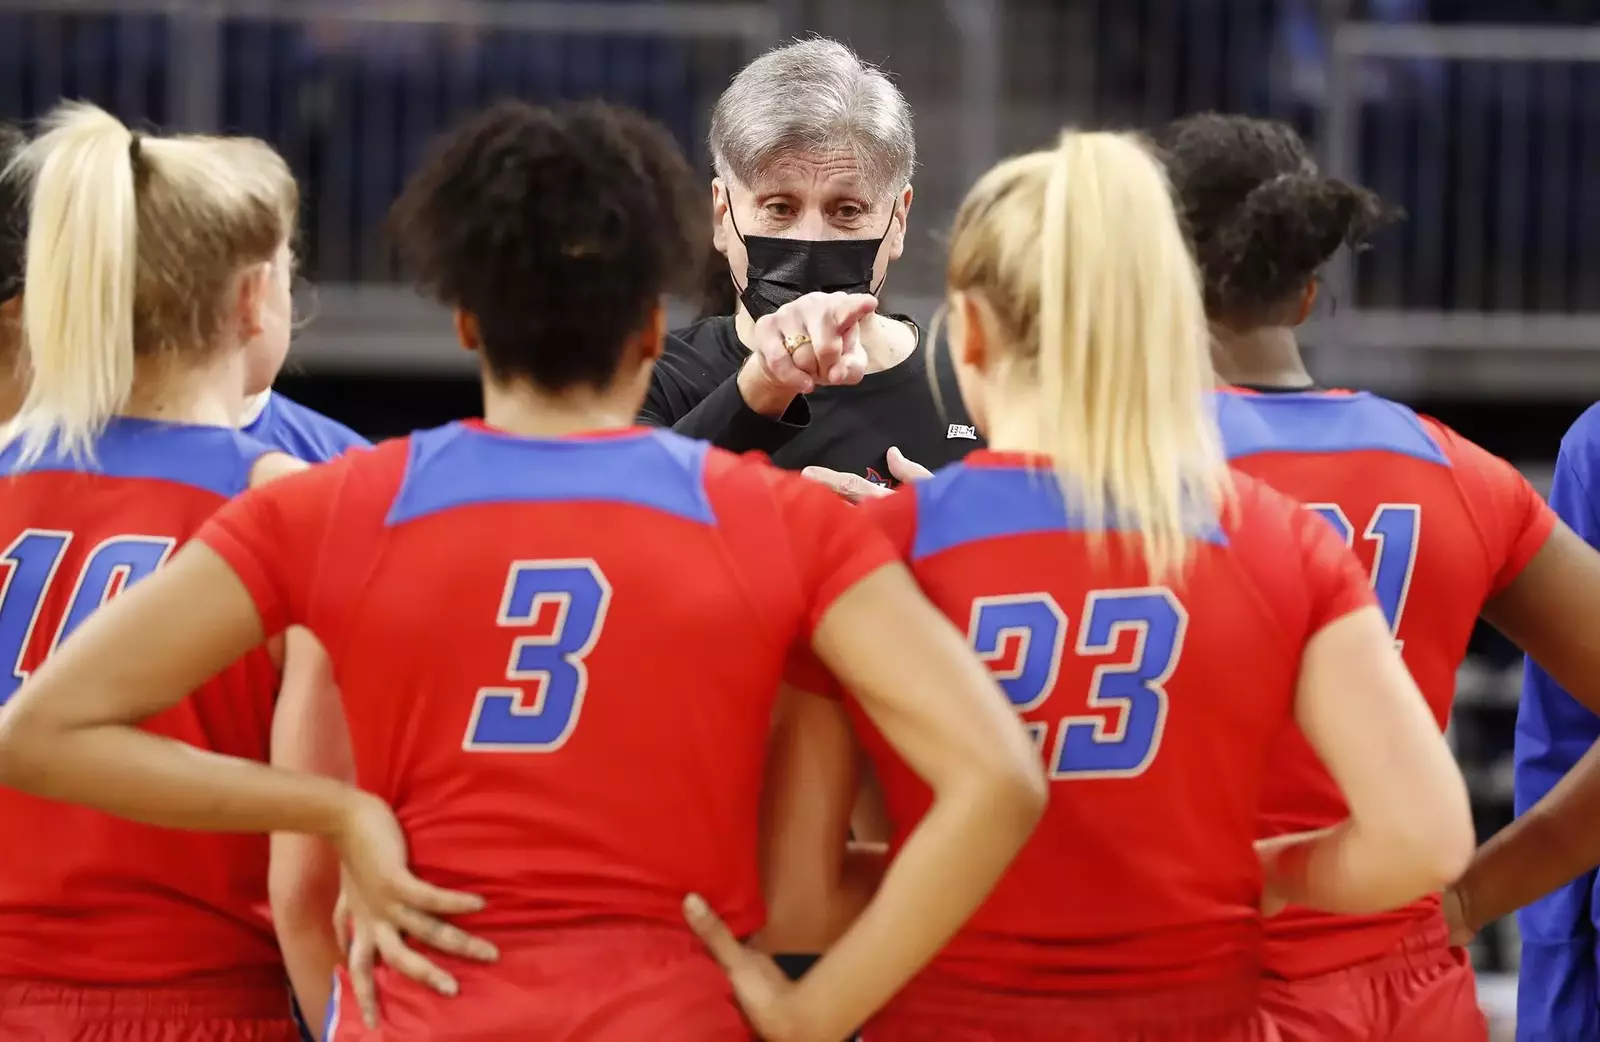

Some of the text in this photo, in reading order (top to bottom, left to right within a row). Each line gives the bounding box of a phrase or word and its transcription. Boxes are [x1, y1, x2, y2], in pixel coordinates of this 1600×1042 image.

[462, 557, 613, 753] 3
[1301, 503, 1421, 654] 1
[967, 586, 1189, 781] 23
